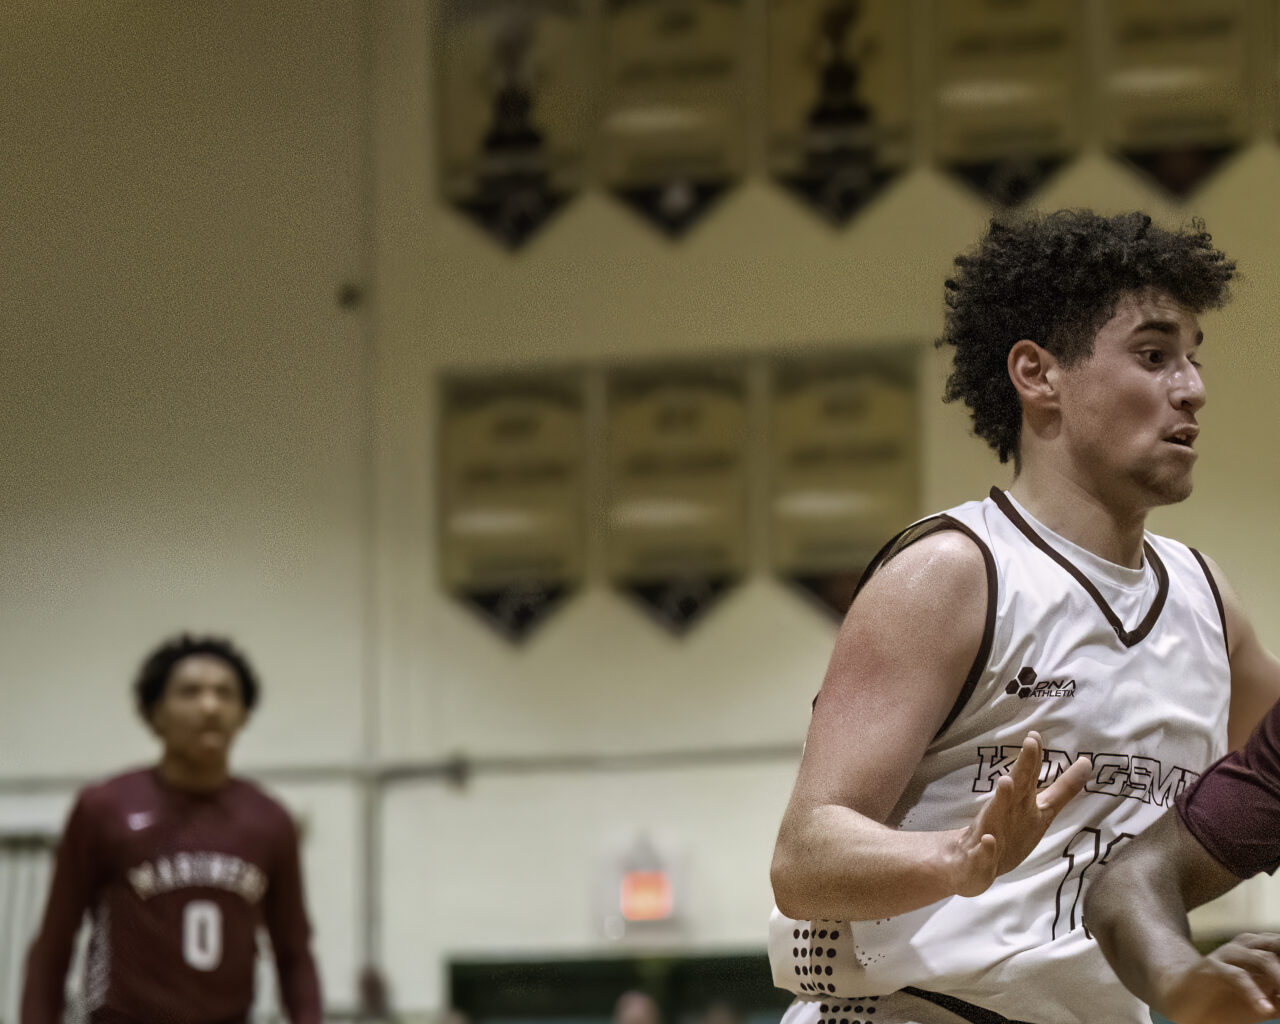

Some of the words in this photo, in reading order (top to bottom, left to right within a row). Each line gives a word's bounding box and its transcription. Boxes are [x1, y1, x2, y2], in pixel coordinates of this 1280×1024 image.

[1030, 689, 1075, 697] ATHLETIX
[1034, 680, 1076, 689] DNA
[972, 745, 1201, 808] KNGSM
[1052, 826, 1135, 940] 1
[183, 901, 222, 971] 0
